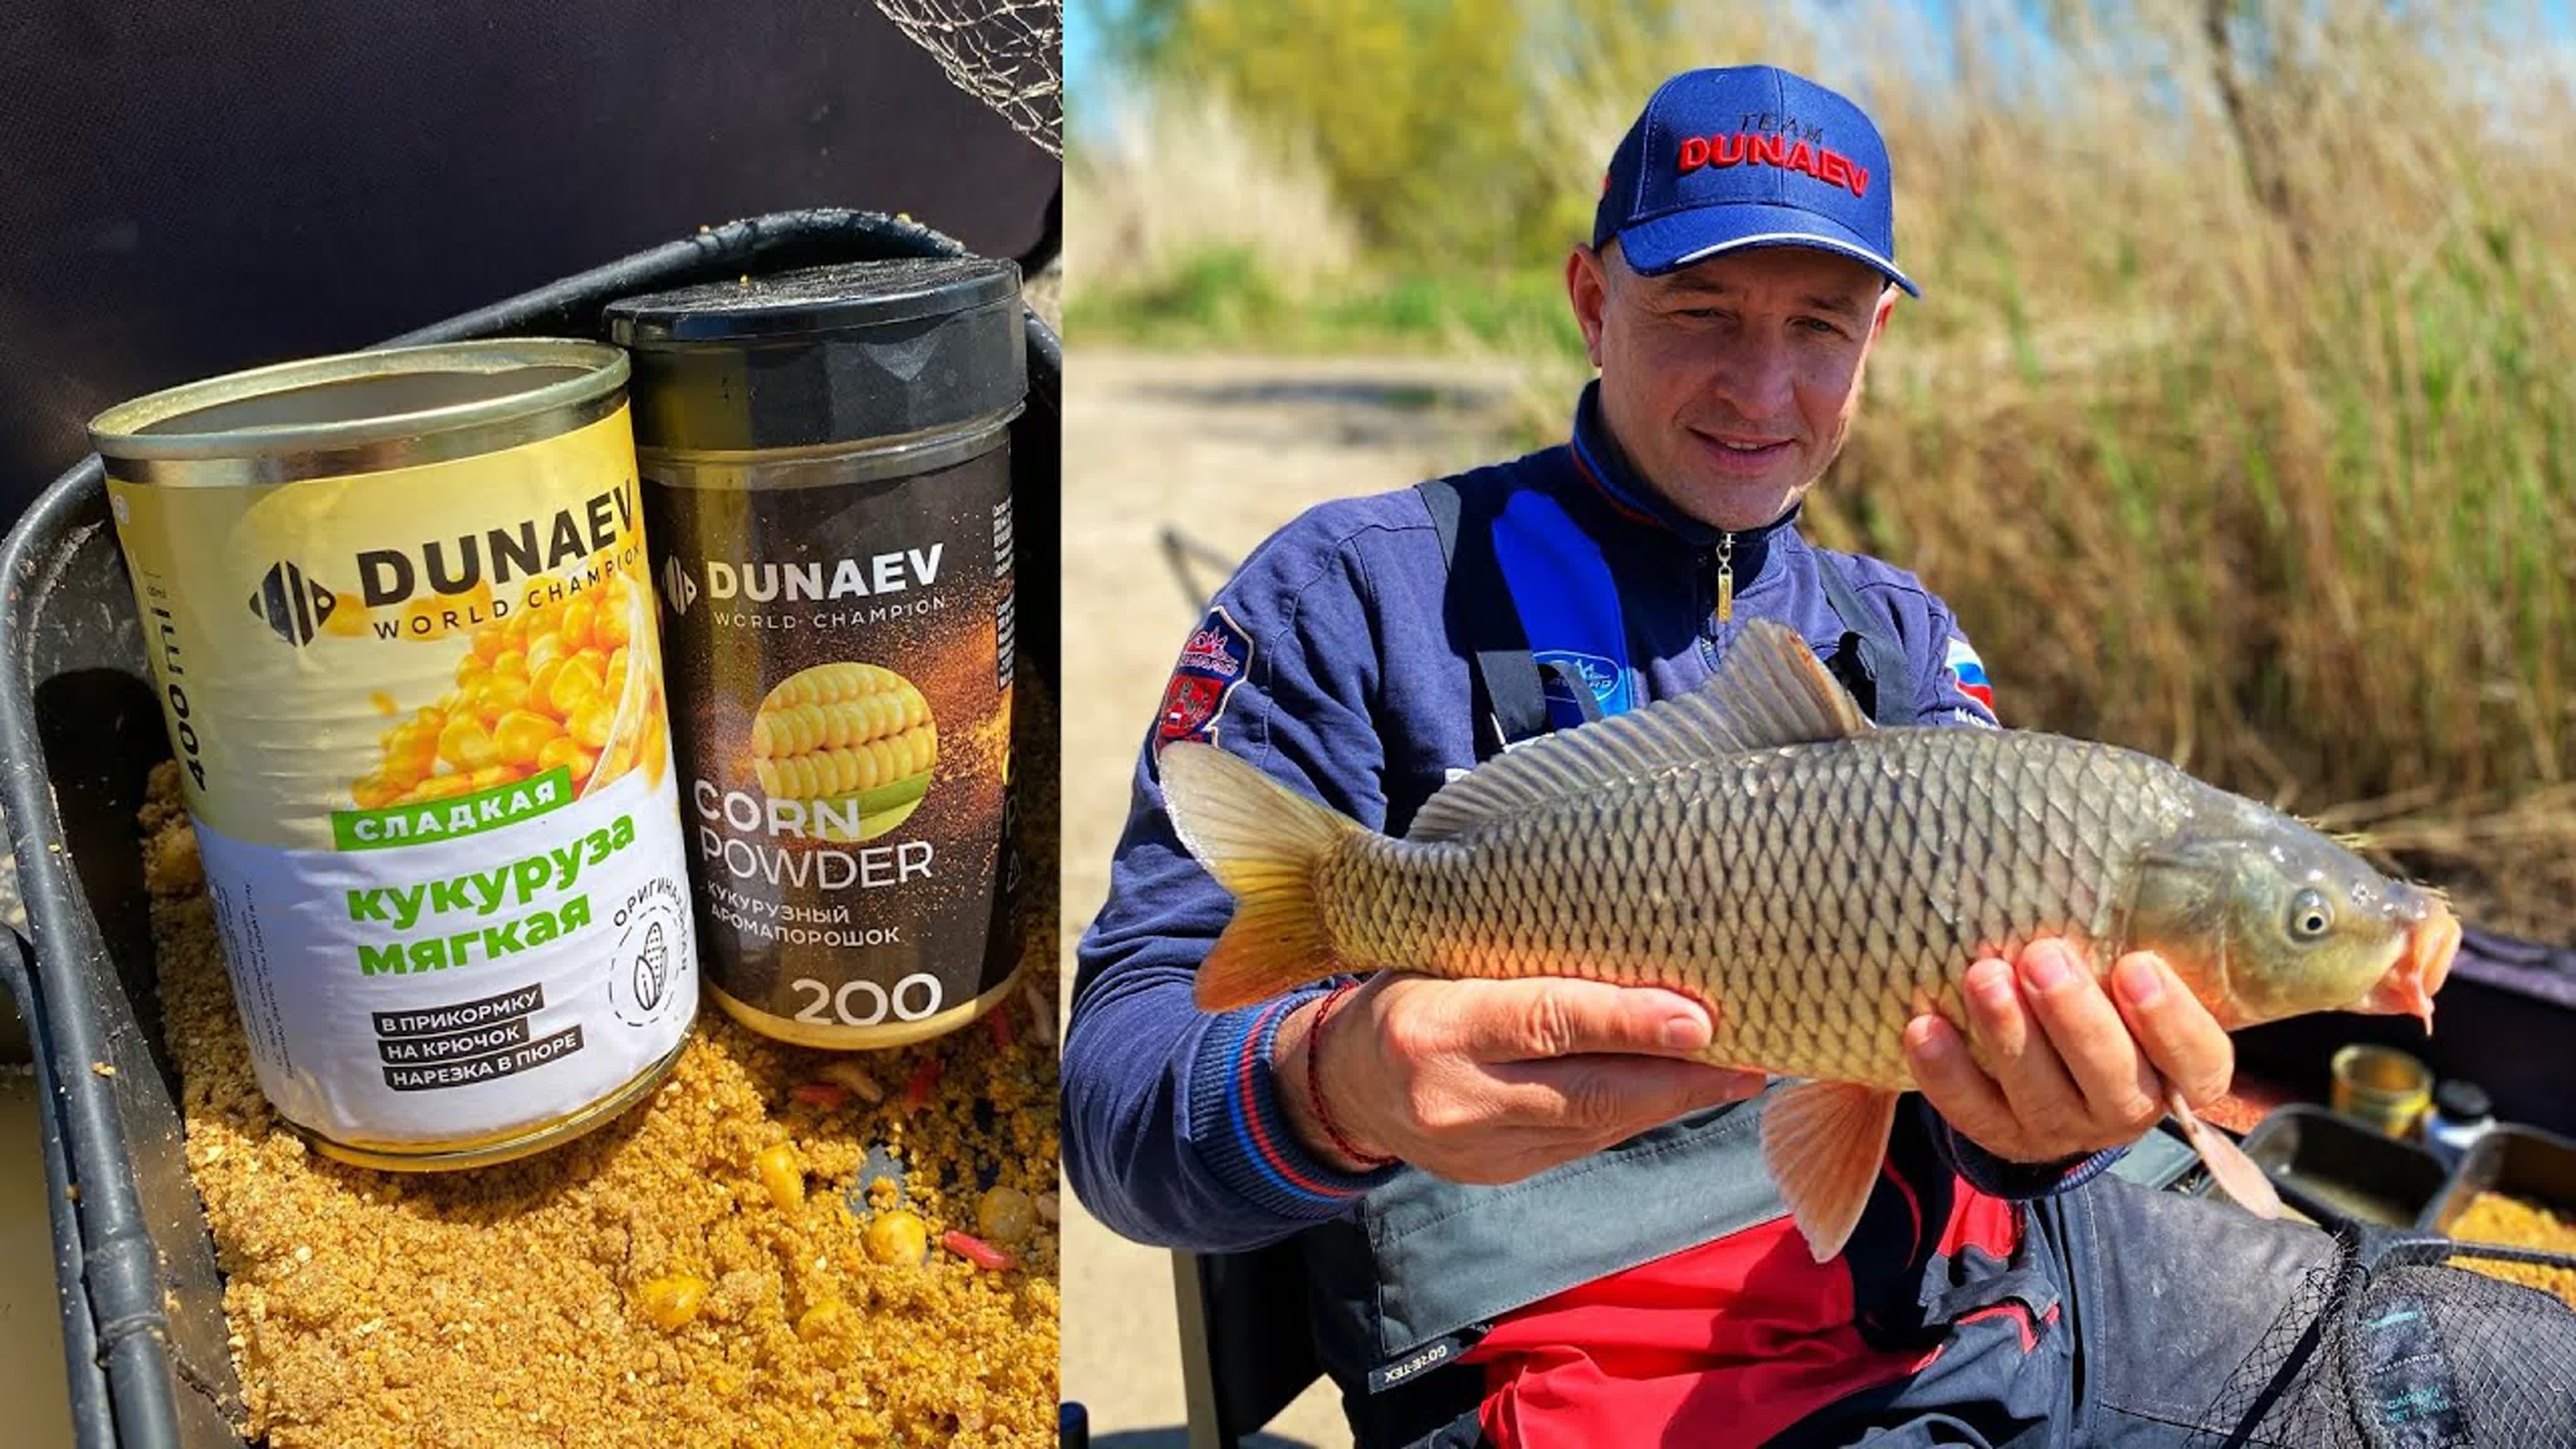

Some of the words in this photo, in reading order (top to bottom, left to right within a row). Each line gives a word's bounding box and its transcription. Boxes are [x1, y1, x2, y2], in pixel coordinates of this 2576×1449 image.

[1740, 113, 1823, 145] TEAM
[1677, 131, 1869, 198] DUNAEV
[355, 478, 631, 609] DUNAEV
[707, 543, 944, 602] DUNAEV
[373, 598, 509, 641] WORLD
[528, 540, 640, 609] CHAMPION
[713, 611, 797, 630] WORLD
[813, 594, 945, 629] CHAMPION
[353, 780, 557, 841] СЛАДКАЯ
[694, 779, 861, 838] CORN
[347, 814, 636, 930] кукуруза
[700, 825, 934, 891] POWDER
[707, 880, 850, 924] КУКУРУЗНЫЙ
[711, 903, 900, 947] АРОМАПОРОШОК
[357, 894, 593, 976] мягкая
[381, 1018, 397, 1032] В
[400, 989, 538, 1031] ПРИКОРМКУ
[791, 973, 943, 1027] 200
[387, 1045, 419, 1060] НА
[423, 1025, 521, 1058] КРЮЧОК
[393, 1061, 494, 1086] НАРЕЗКА
[497, 1057, 513, 1072] В
[516, 1031, 577, 1067] ПЮРЕ
